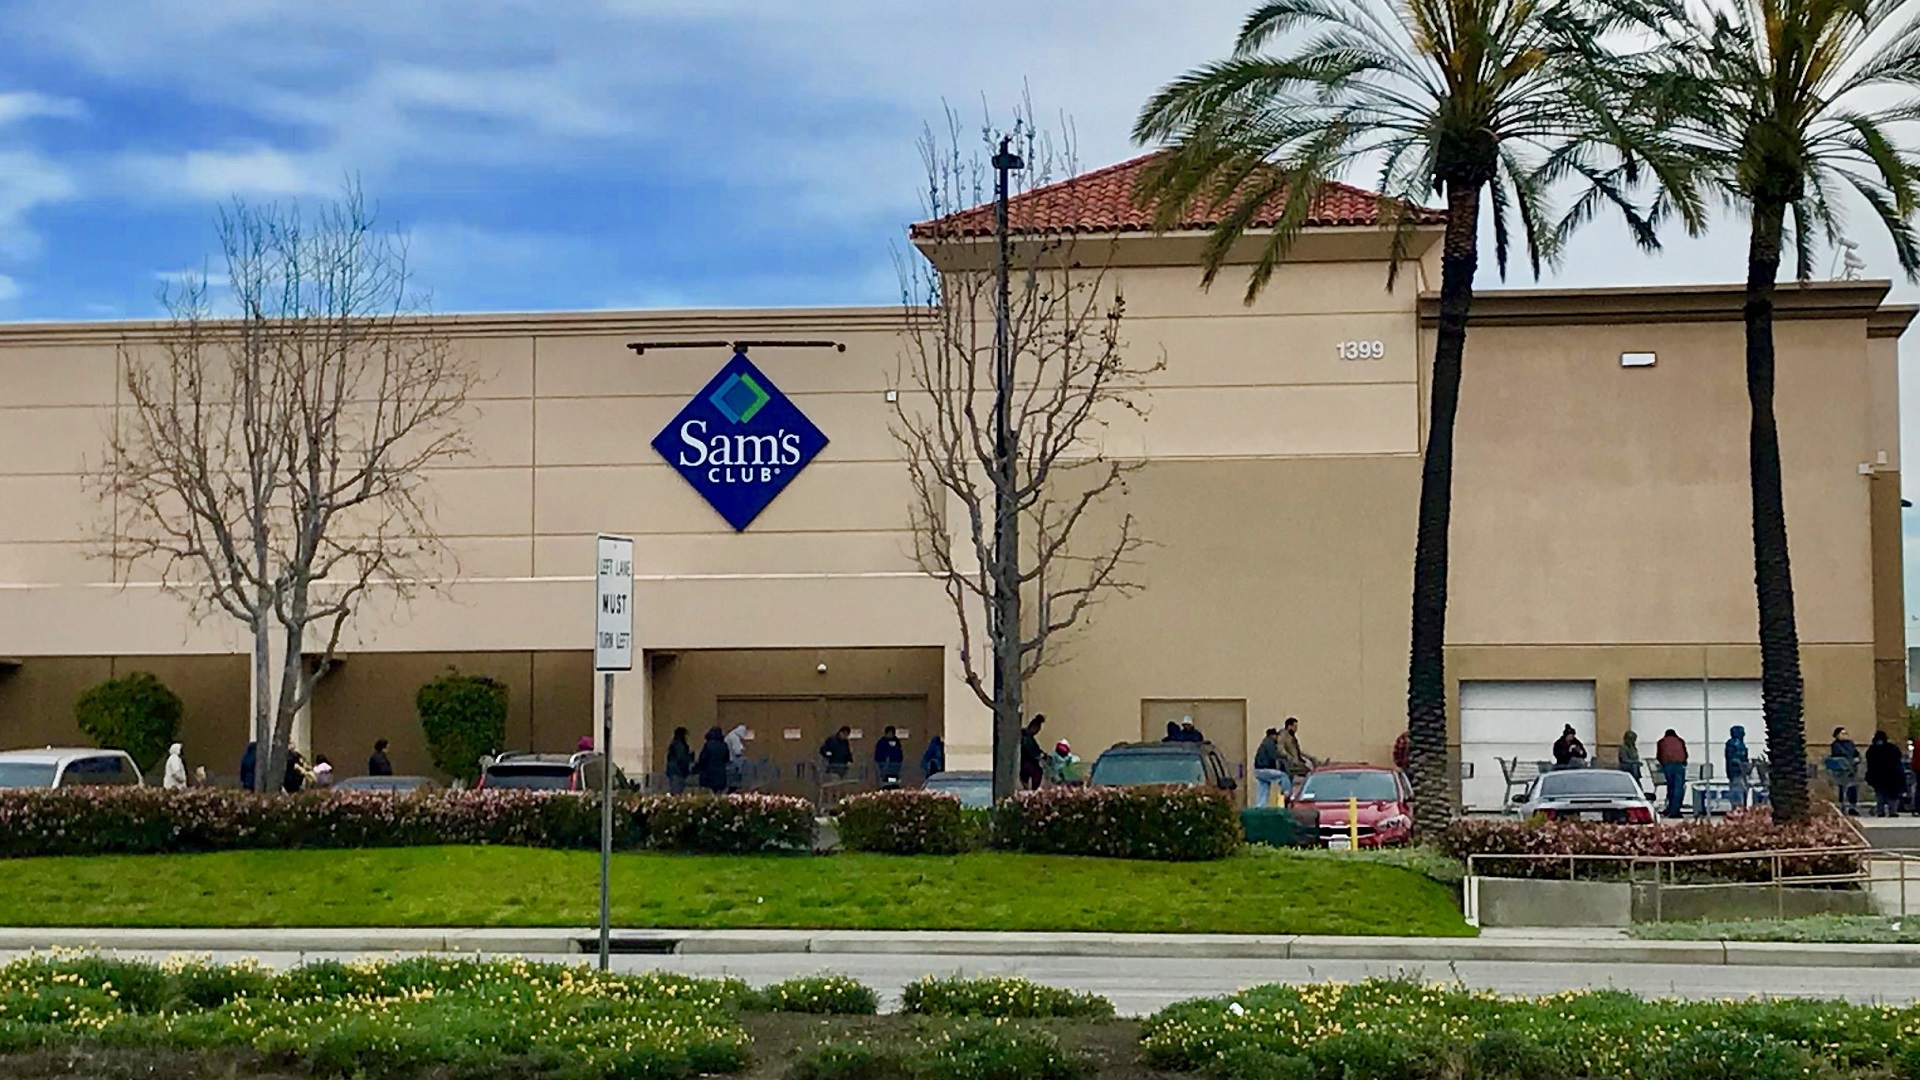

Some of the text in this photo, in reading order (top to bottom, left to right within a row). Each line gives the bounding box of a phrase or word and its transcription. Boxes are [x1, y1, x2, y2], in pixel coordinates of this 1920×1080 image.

[1336, 340, 1384, 359] 1399
[679, 420, 800, 466] Sam's
[600, 558, 631, 577] LEFT LANE
[603, 594, 627, 614] MUST
[599, 631, 630, 648] TURN LEFT
